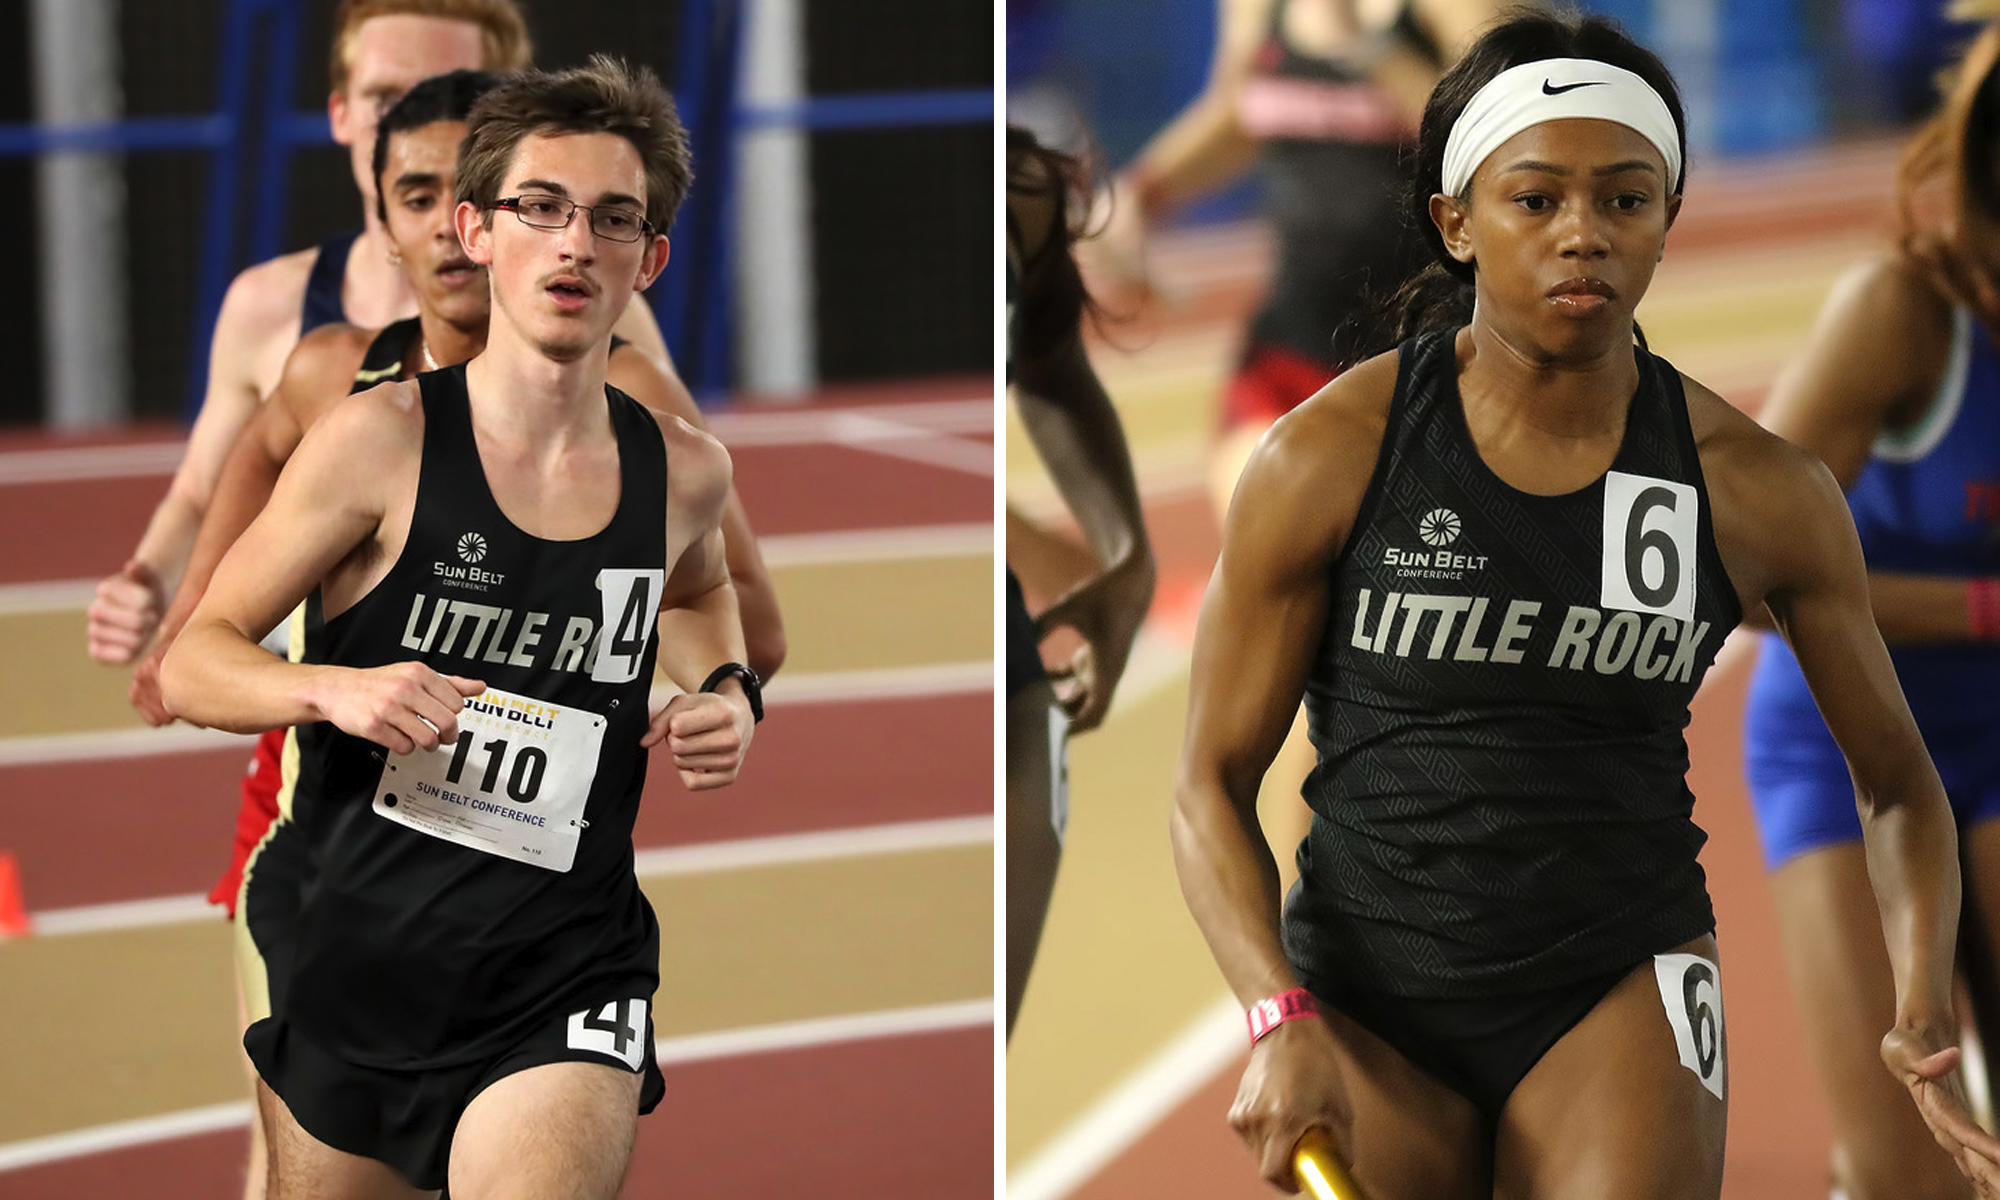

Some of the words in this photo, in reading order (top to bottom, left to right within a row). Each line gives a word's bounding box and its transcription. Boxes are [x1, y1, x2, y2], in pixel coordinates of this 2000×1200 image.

[433, 561, 466, 579] SUN
[469, 566, 505, 586] BELT
[1383, 547, 1431, 568] SUN
[1433, 550, 1488, 571] BELT
[1396, 568, 1464, 581] CONFERENCE
[1625, 486, 1681, 608] 6
[442, 578, 488, 592] CONFERENCE
[400, 593, 550, 668] LITTLE
[610, 577, 650, 675] 4
[1351, 588, 1543, 664] LITTLE
[1547, 605, 1712, 684] ROCK
[464, 712, 550, 741] ONFERENCE
[445, 729, 548, 804] 110
[416, 781, 440, 798] SUN
[441, 790, 470, 806] BELT
[471, 799, 547, 828] CONFERENCE
[583, 999, 636, 1056] 4
[1683, 962, 1716, 1080] 6
